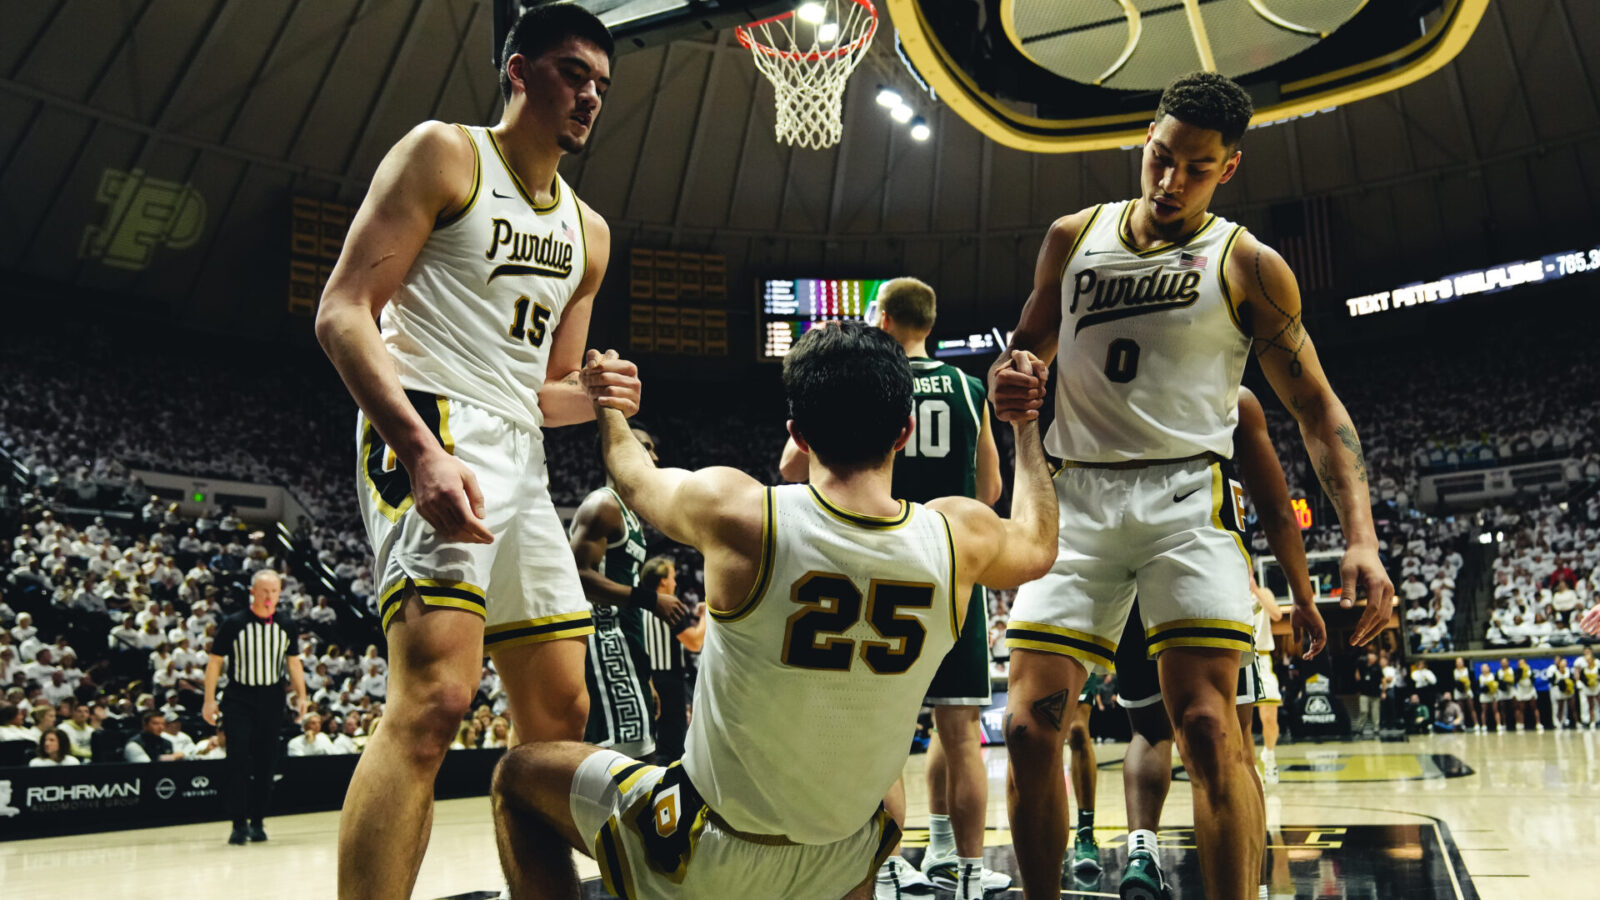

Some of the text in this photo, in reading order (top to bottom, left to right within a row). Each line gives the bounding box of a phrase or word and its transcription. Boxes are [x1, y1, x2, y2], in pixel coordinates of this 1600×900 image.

[486, 218, 573, 274] Purdue
[1069, 265, 1201, 320] Purdue
[1346, 292, 1390, 317] TEXT
[508, 295, 551, 348] 15
[1104, 337, 1140, 383] 0
[780, 570, 936, 675] 25
[26, 777, 140, 807] ROHRMAN
